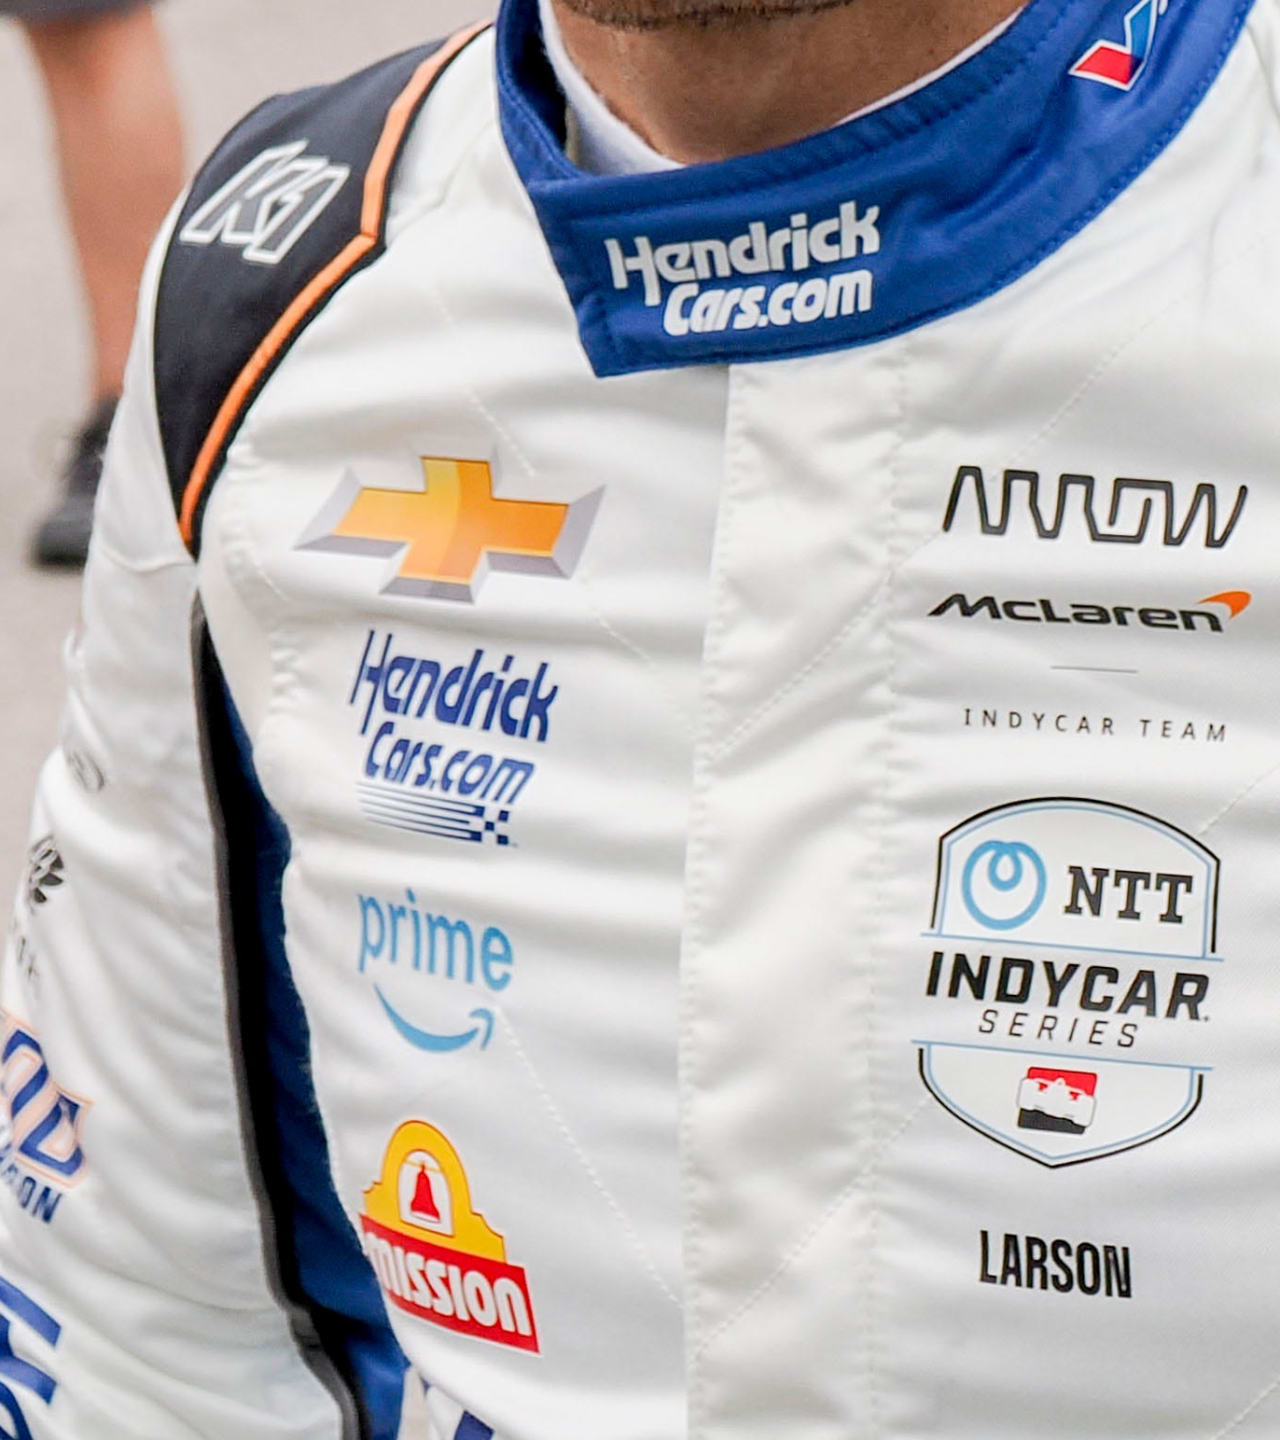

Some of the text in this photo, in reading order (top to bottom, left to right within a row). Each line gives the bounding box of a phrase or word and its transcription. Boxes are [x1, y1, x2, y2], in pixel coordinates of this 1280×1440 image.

[179, 137, 352, 264] K1
[604, 200, 881, 306] Hendrick
[663, 269, 874, 337] Cars.com
[942, 465, 1249, 549] ARROW
[926, 592, 1225, 633] McLaren
[349, 629, 559, 743] Hendrick
[963, 707, 1228, 743] INDYCAR TEAM
[365, 721, 536, 804] Cars.com
[1063, 864, 1194, 924] NTT
[357, 886, 515, 992] prime
[925, 950, 1210, 1021] INDYCAR
[978, 1008, 1139, 1048] SERIES
[978, 1229, 1133, 1299] LARSON
